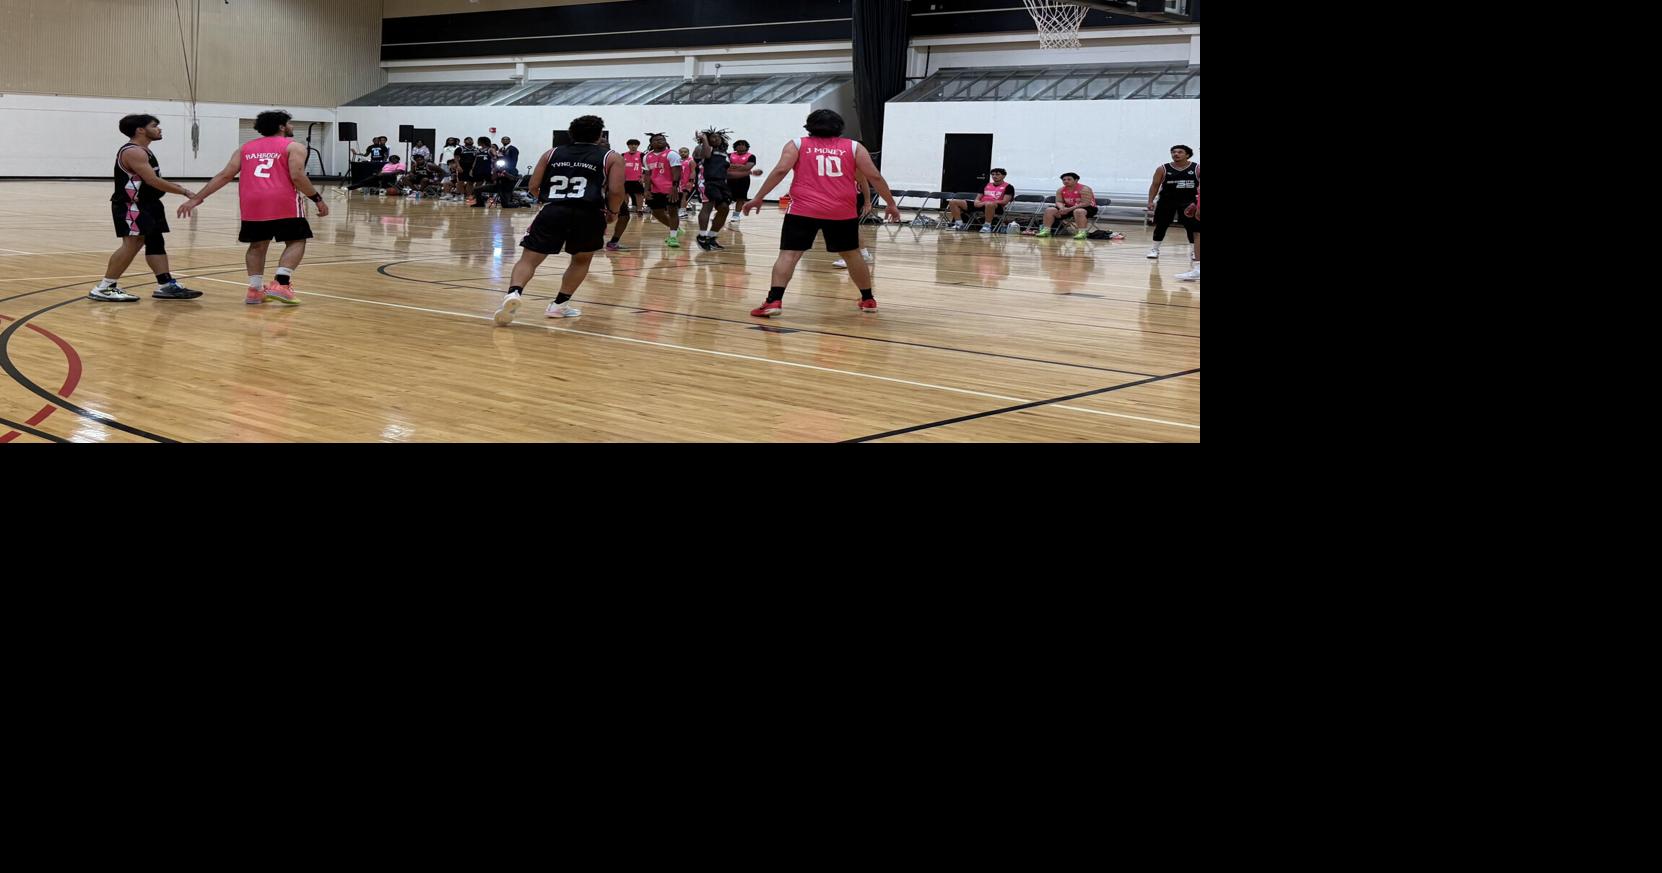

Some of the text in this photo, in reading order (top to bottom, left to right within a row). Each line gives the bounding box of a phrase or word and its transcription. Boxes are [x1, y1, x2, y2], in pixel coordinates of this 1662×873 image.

[814, 147, 846, 156] MONEY
[254, 158, 274, 178] 2
[816, 155, 843, 177] 10
[548, 175, 588, 199] 23
